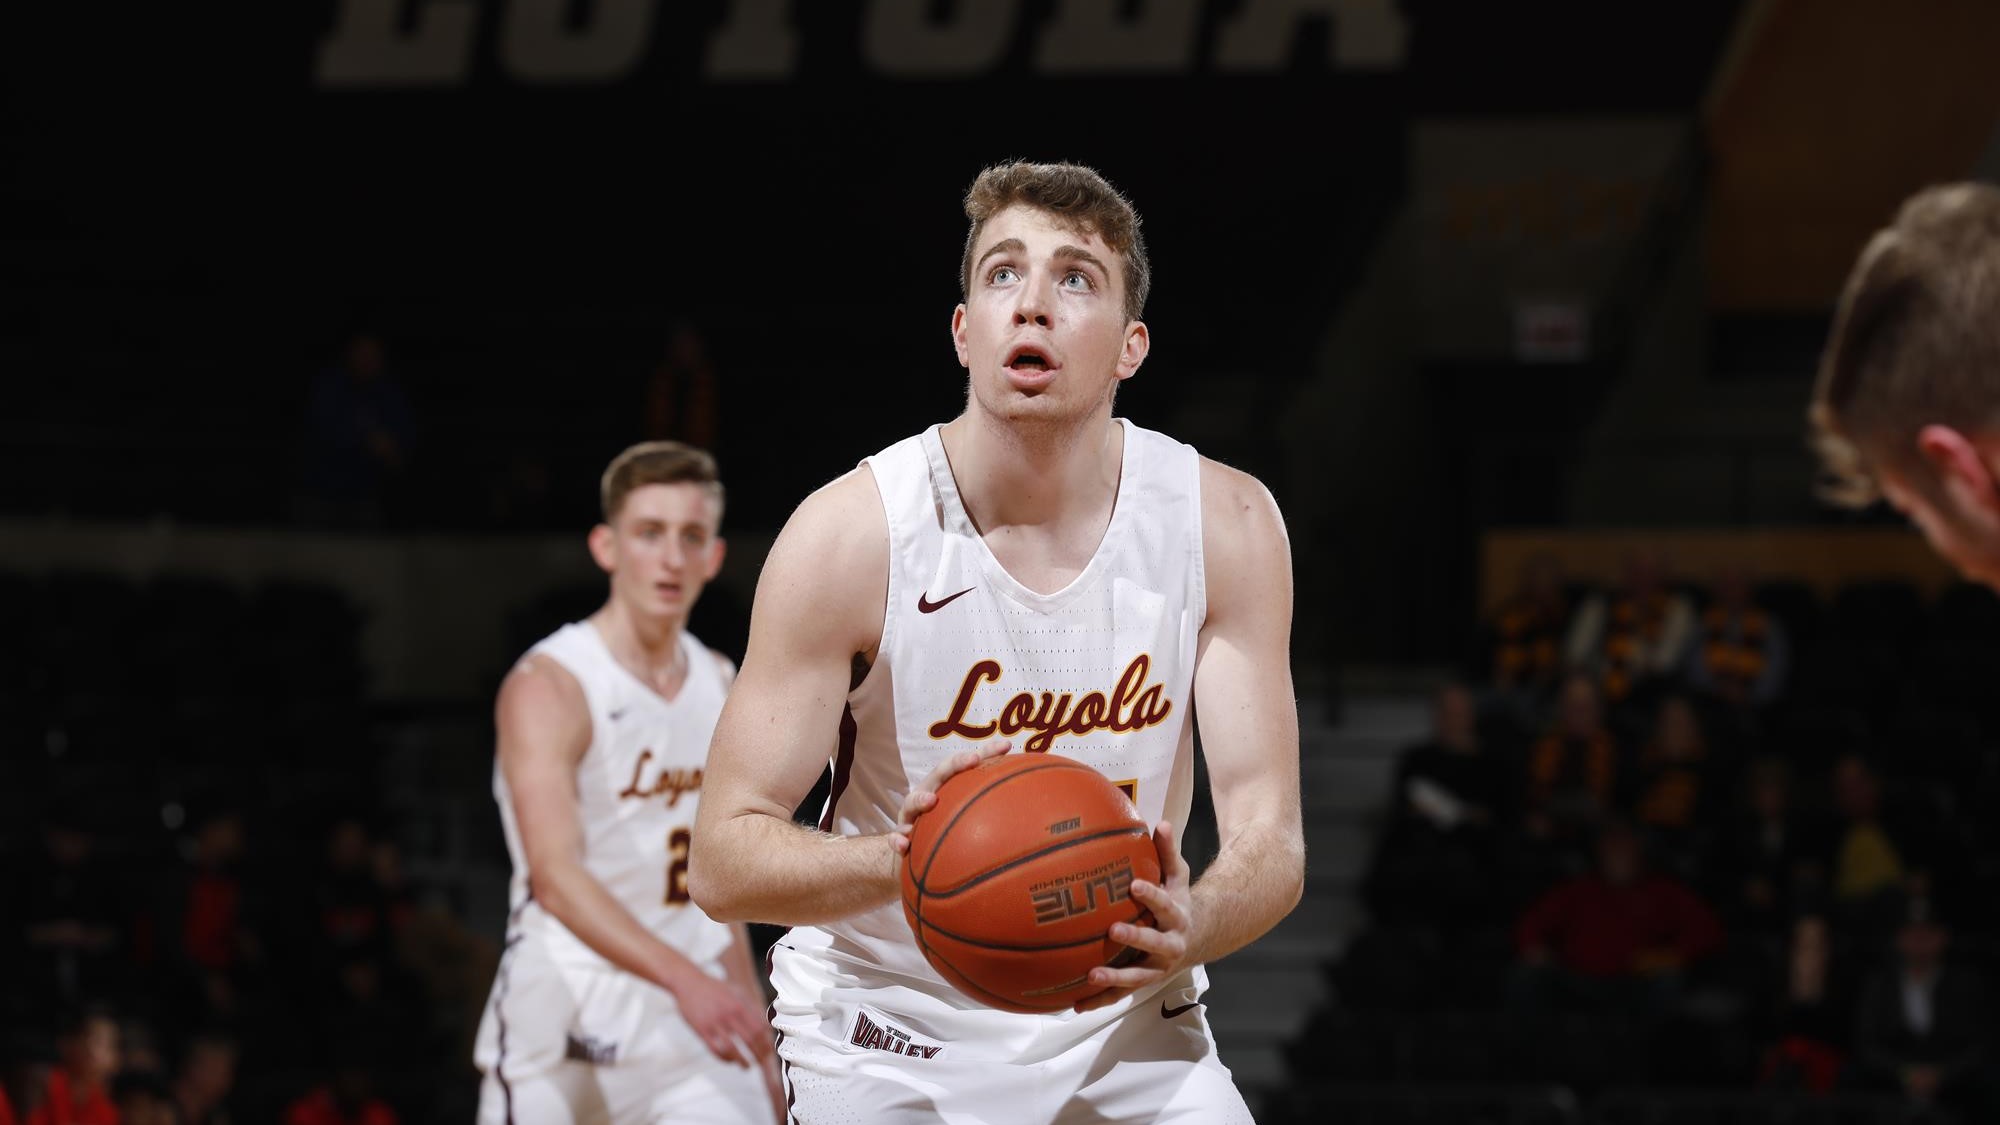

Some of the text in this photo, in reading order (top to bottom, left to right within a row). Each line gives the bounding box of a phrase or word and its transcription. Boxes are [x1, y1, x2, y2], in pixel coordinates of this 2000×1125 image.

[927, 653, 1173, 752] Loyola
[1029, 855, 1131, 892] CHAMPIONSHIP
[1031, 864, 1135, 927] ELITE
